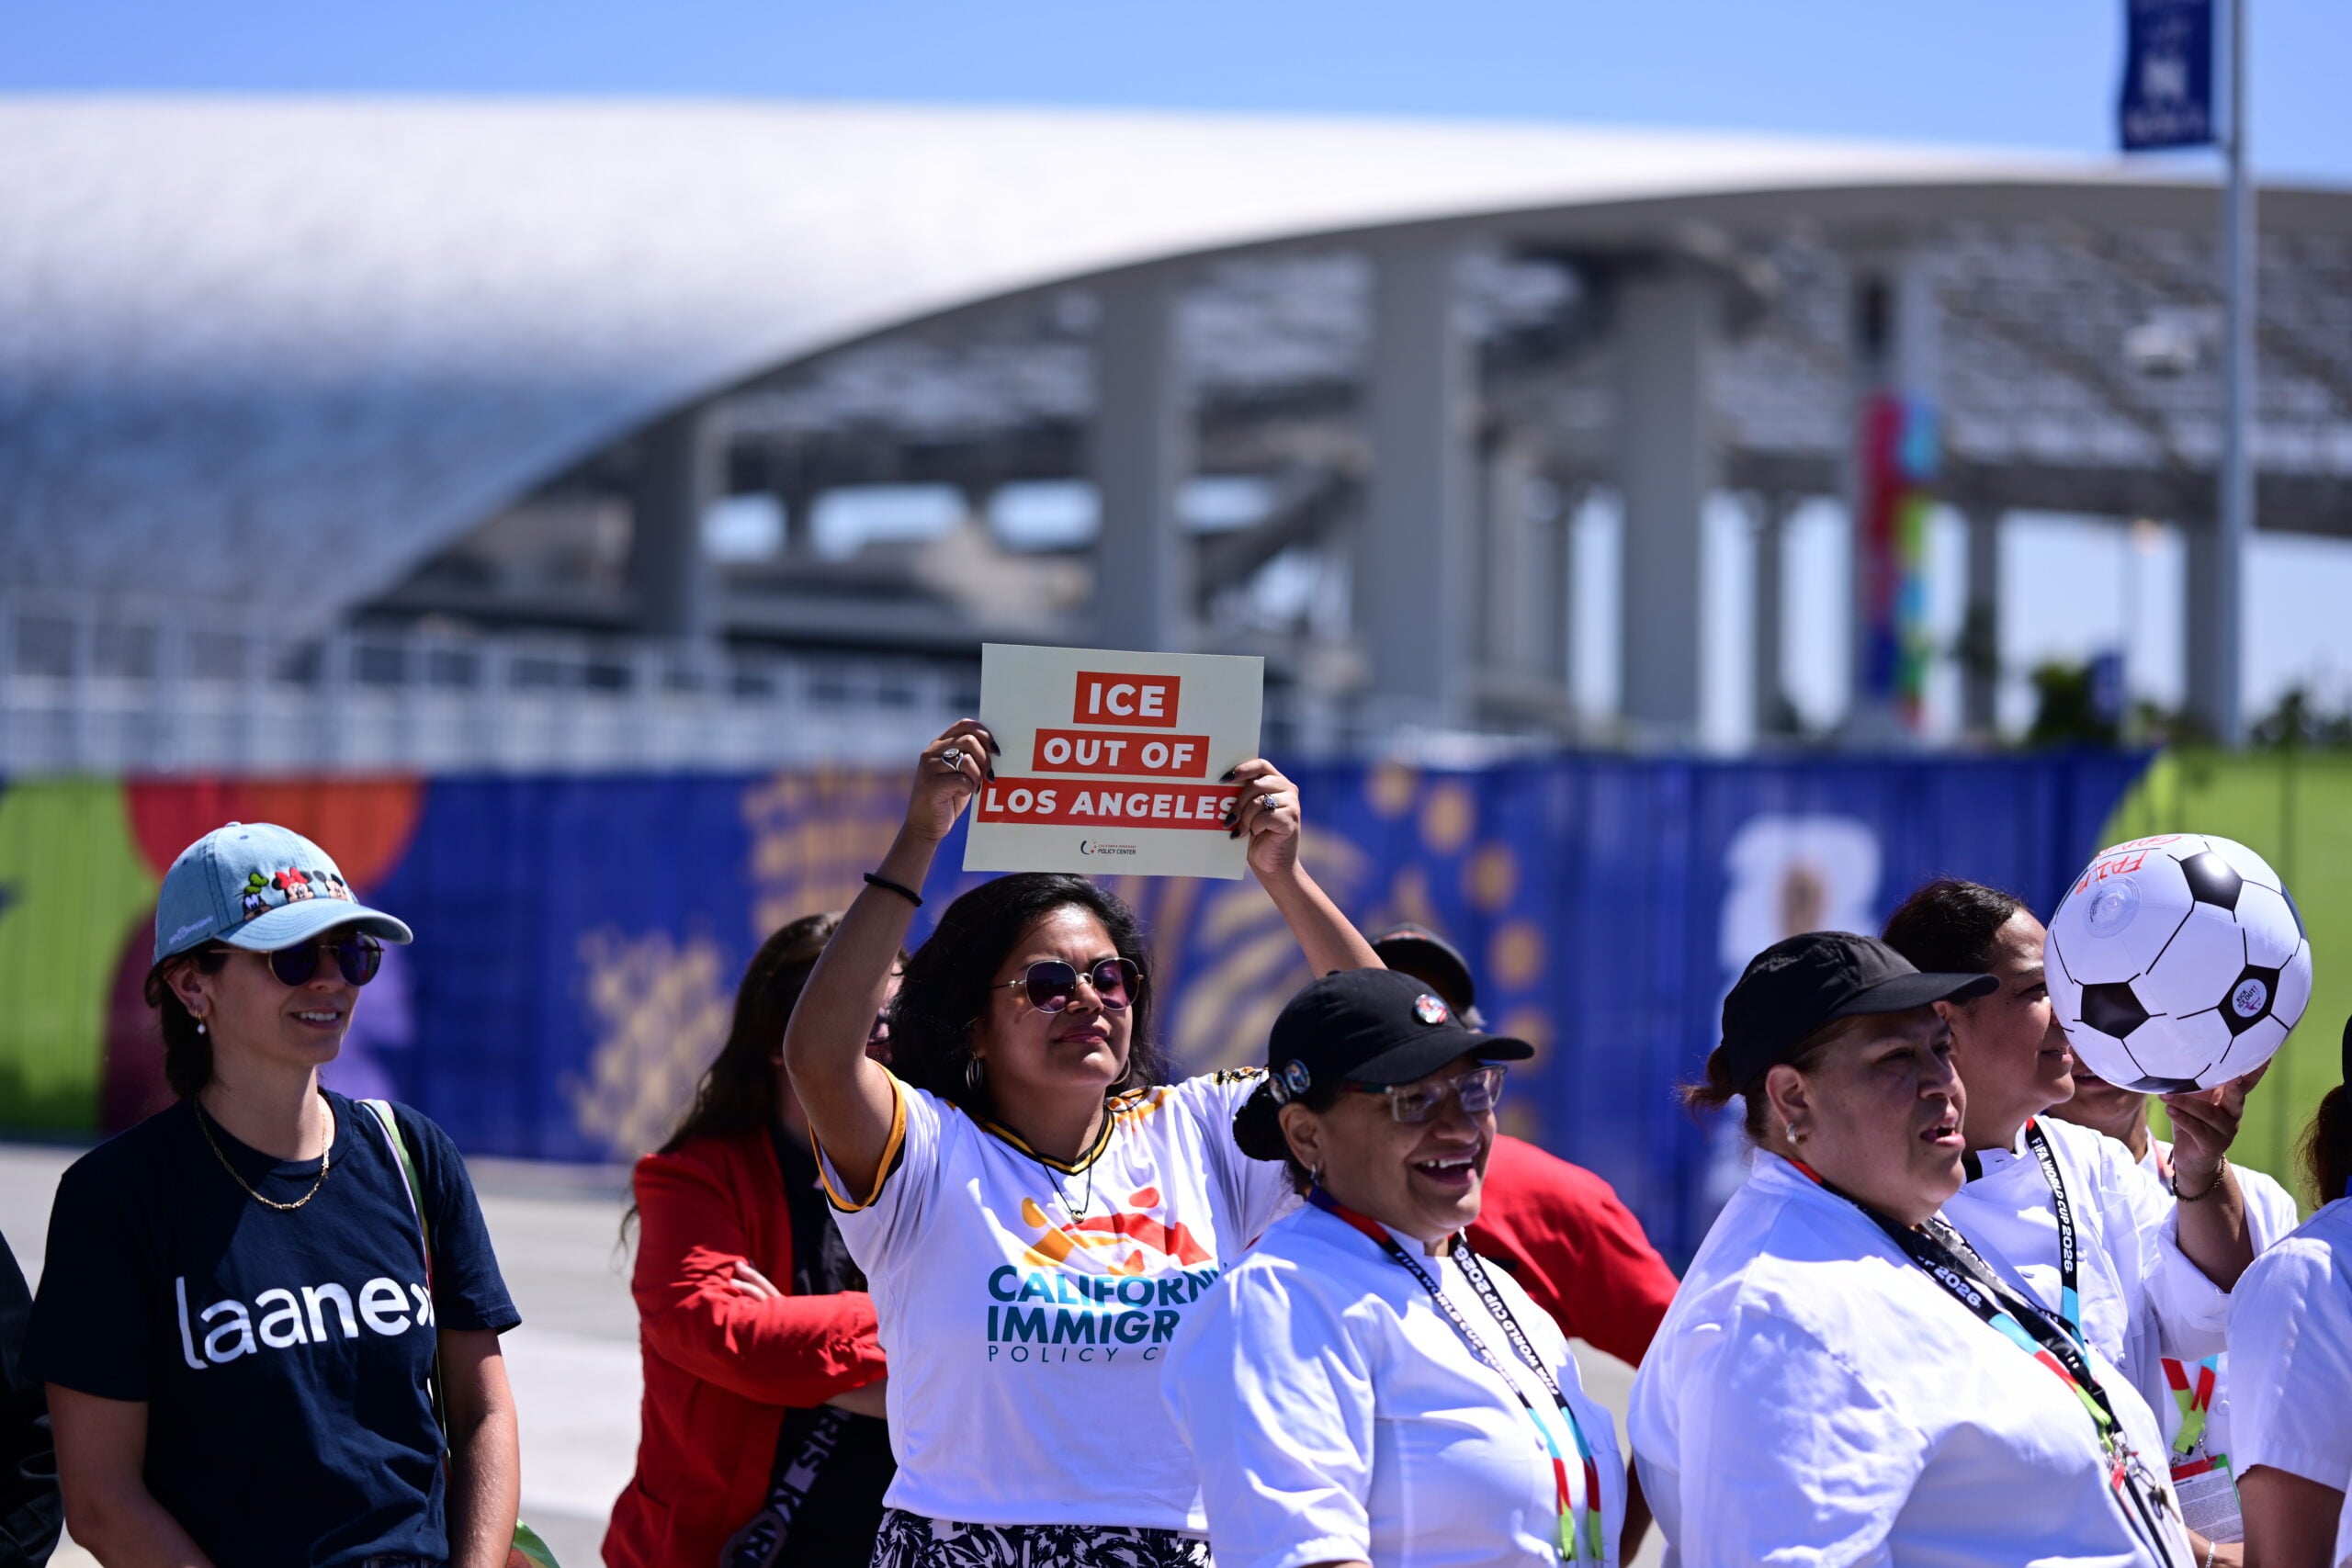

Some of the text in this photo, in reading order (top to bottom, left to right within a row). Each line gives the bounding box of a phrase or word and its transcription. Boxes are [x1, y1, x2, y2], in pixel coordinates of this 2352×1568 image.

[1088, 682, 1166, 717] ICE
[1043, 737, 1194, 770] OUT OF
[984, 787, 1238, 820] LOS ANGELES
[2075, 849, 2149, 896] FAIR
[2236, 988, 2249, 1002] KICK
[2245, 984, 2258, 1001] OUT!
[2030, 1136, 2074, 1272] FIFA WORLD CUP 2026
[988, 1265, 1227, 1308] CALIFORN
[1453, 1245, 1491, 1293] 2026
[1934, 1266, 1982, 1308] 2026
[1484, 1294, 1509, 1320] CUP
[989, 1345, 1119, 1363] POLICY
[1502, 1319, 1540, 1370] WORLD
